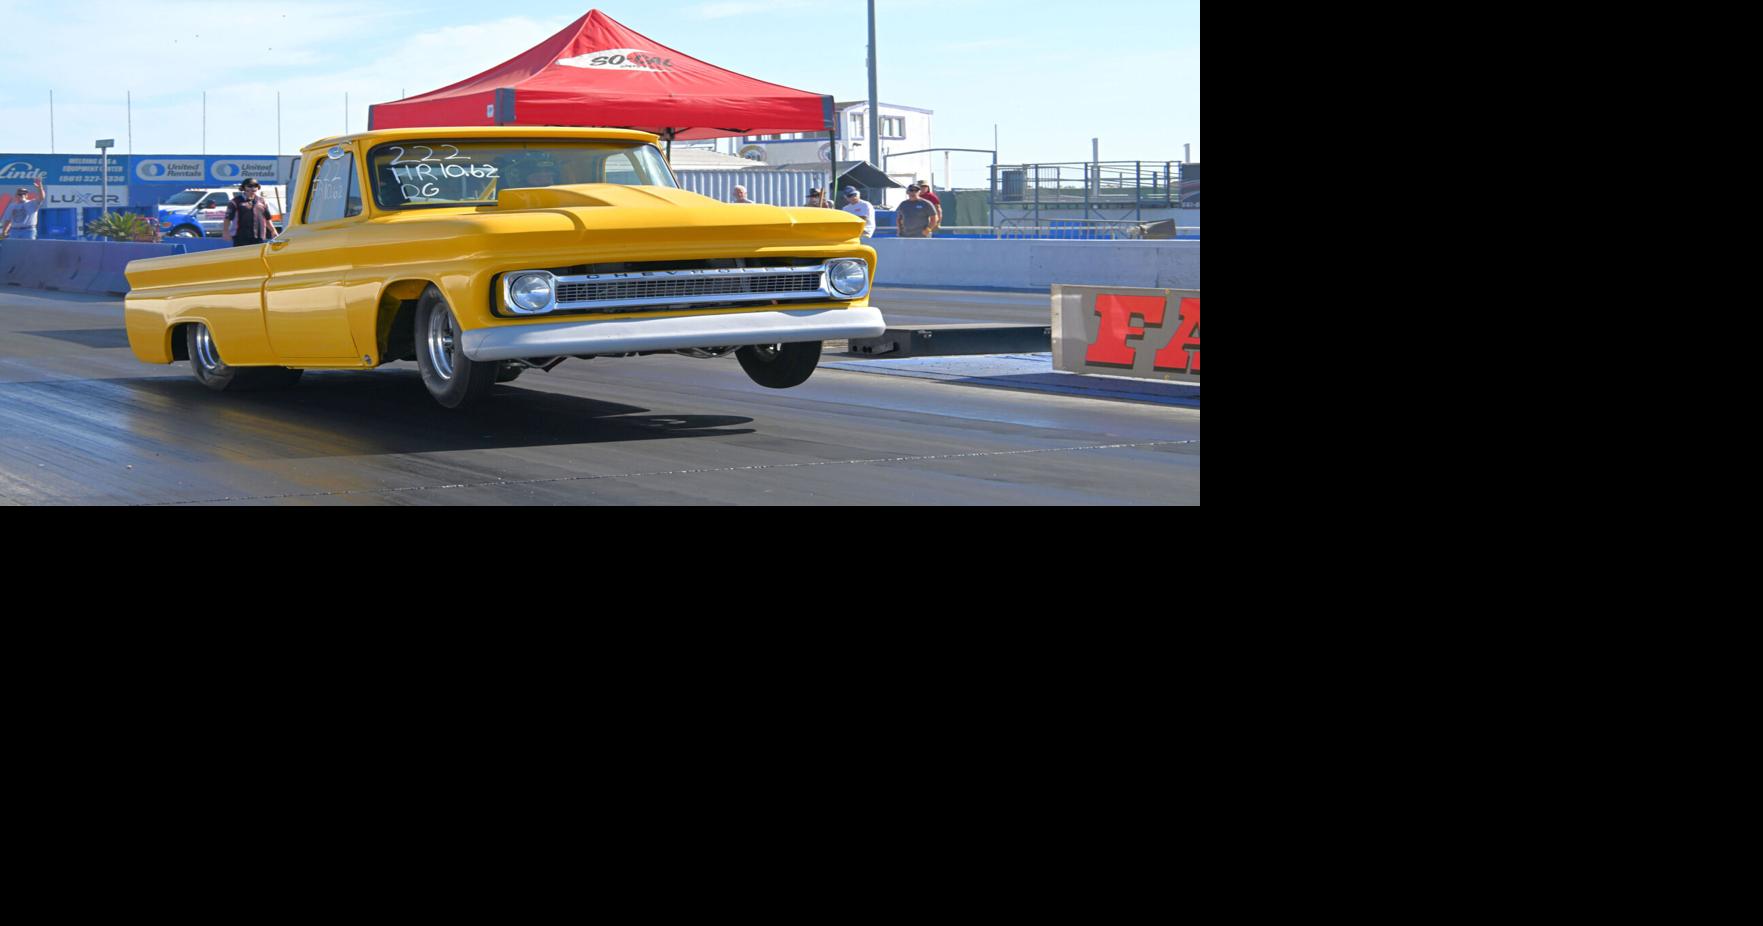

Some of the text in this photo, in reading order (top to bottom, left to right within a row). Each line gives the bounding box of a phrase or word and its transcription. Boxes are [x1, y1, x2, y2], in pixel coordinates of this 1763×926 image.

[390, 144, 471, 165] 222
[0, 161, 47, 179] Linde
[51, 192, 119, 203] LUXOR
[401, 183, 440, 199] DG
[1085, 294, 1200, 374] FA
